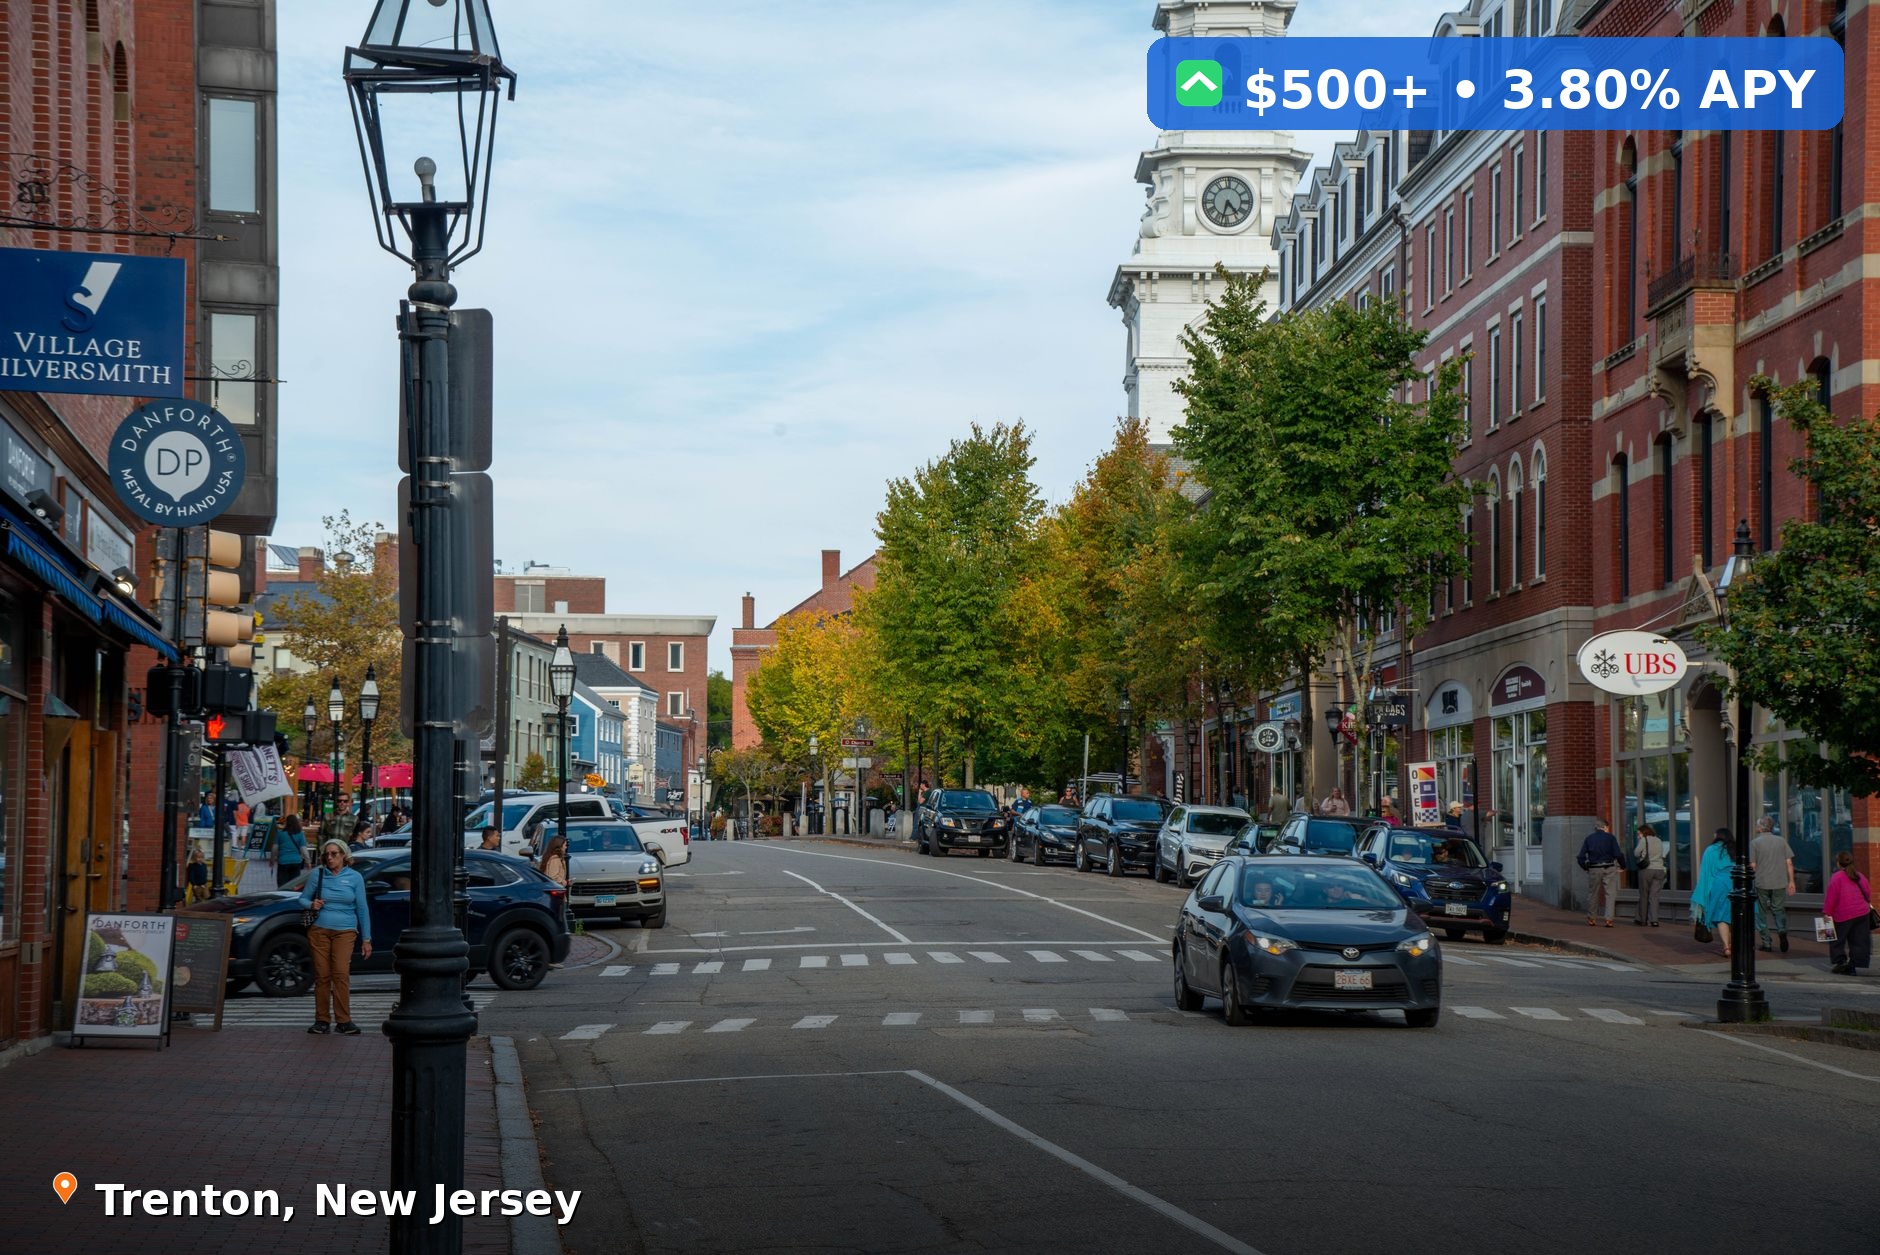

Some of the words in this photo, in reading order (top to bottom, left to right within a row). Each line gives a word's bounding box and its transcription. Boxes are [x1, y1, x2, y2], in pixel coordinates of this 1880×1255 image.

[14, 331, 142, 359] VILLAGE
[0, 357, 172, 385] ILVERSMITH
[157, 448, 203, 477] DP
[121, 468, 151, 508] METAL
[154, 503, 174, 516] BY
[177, 495, 217, 517] HAND
[214, 470, 234, 495] USA
[1623, 652, 1677, 675] UBS
[240, 774, 254, 791] SHOP
[1411, 769, 1422, 821] OPEN
[96, 920, 166, 930] DANFORTH
